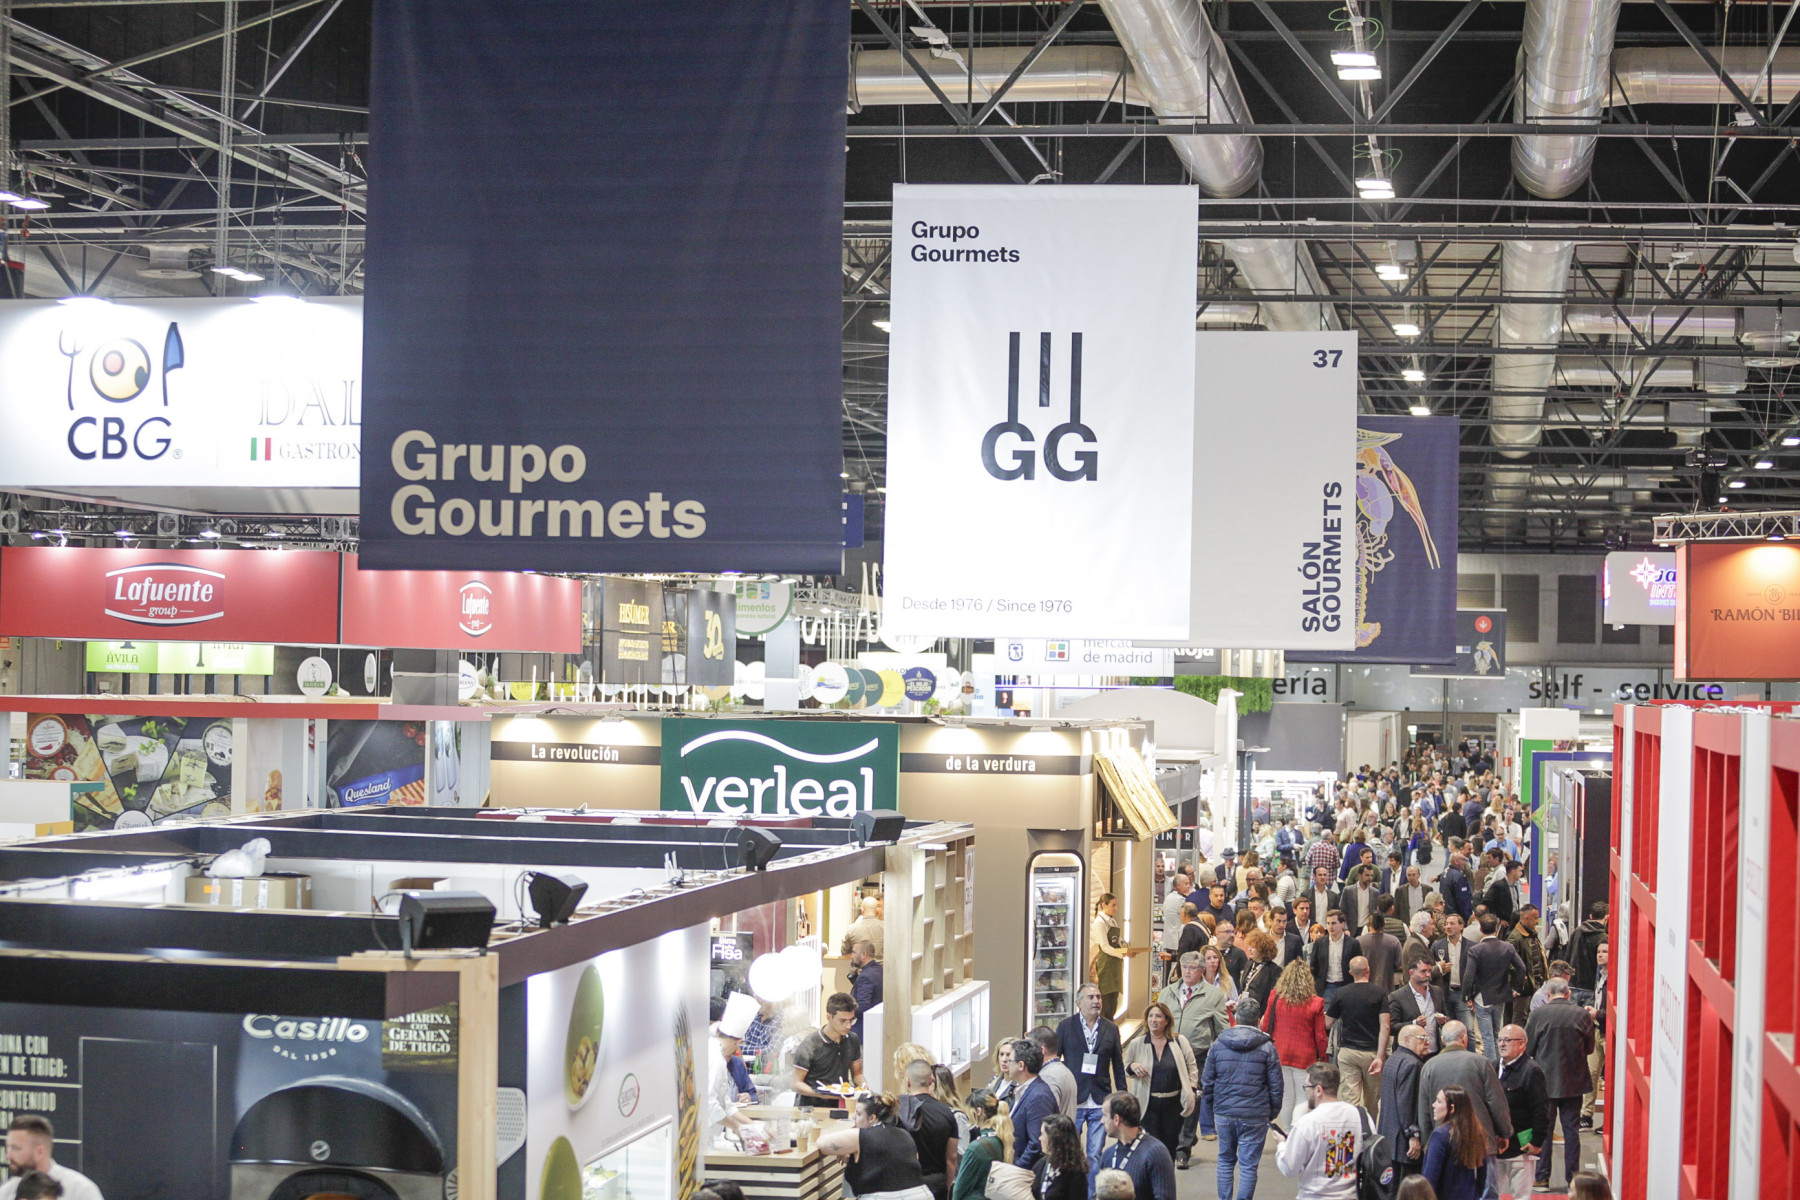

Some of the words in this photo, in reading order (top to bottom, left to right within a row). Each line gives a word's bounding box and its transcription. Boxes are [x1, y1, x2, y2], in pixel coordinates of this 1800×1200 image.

[909, 221, 980, 242] Grupo
[911, 244, 1020, 262] Gourmets
[1313, 350, 1343, 368] 37
[67, 416, 172, 461] CBG
[391, 429, 587, 493] Grupo
[391, 484, 707, 539] Gourmets
[1323, 481, 1342, 632] GOURMETS
[115, 577, 213, 605] Lafuente
[1298, 542, 1321, 632] SALÓN
[148, 606, 178, 617] group
[902, 597, 947, 610] Desde
[951, 599, 983, 611] 1976
[997, 598, 1036, 612] Since
[1040, 600, 1073, 613] 1976
[1711, 606, 1774, 621] RAMÓN
[107, 651, 138, 663] ÁVILA
[1083, 652, 1100, 663] de
[1106, 651, 1153, 664] madrid
[1619, 680, 1724, 700] service
[531, 744, 546, 758] La
[550, 746, 619, 761] revolución
[945, 756, 962, 771] de
[966, 756, 979, 771] la
[983, 757, 1036, 772] verdura
[345, 777, 392, 803] Quesland
[680, 764, 874, 818] verleal
[242, 1013, 369, 1043] Casillo
[389, 1027, 450, 1042] GERMEN
[25, 1035, 49, 1055] CON
[273, 1045, 298, 1061] DAL
[389, 1040, 407, 1051] DE
[409, 1041, 451, 1053] TRIGO
[12, 1056, 28, 1076] DE
[30, 1056, 68, 1078] TRIGO:
[0, 1089, 57, 1112] ONTENIDO
